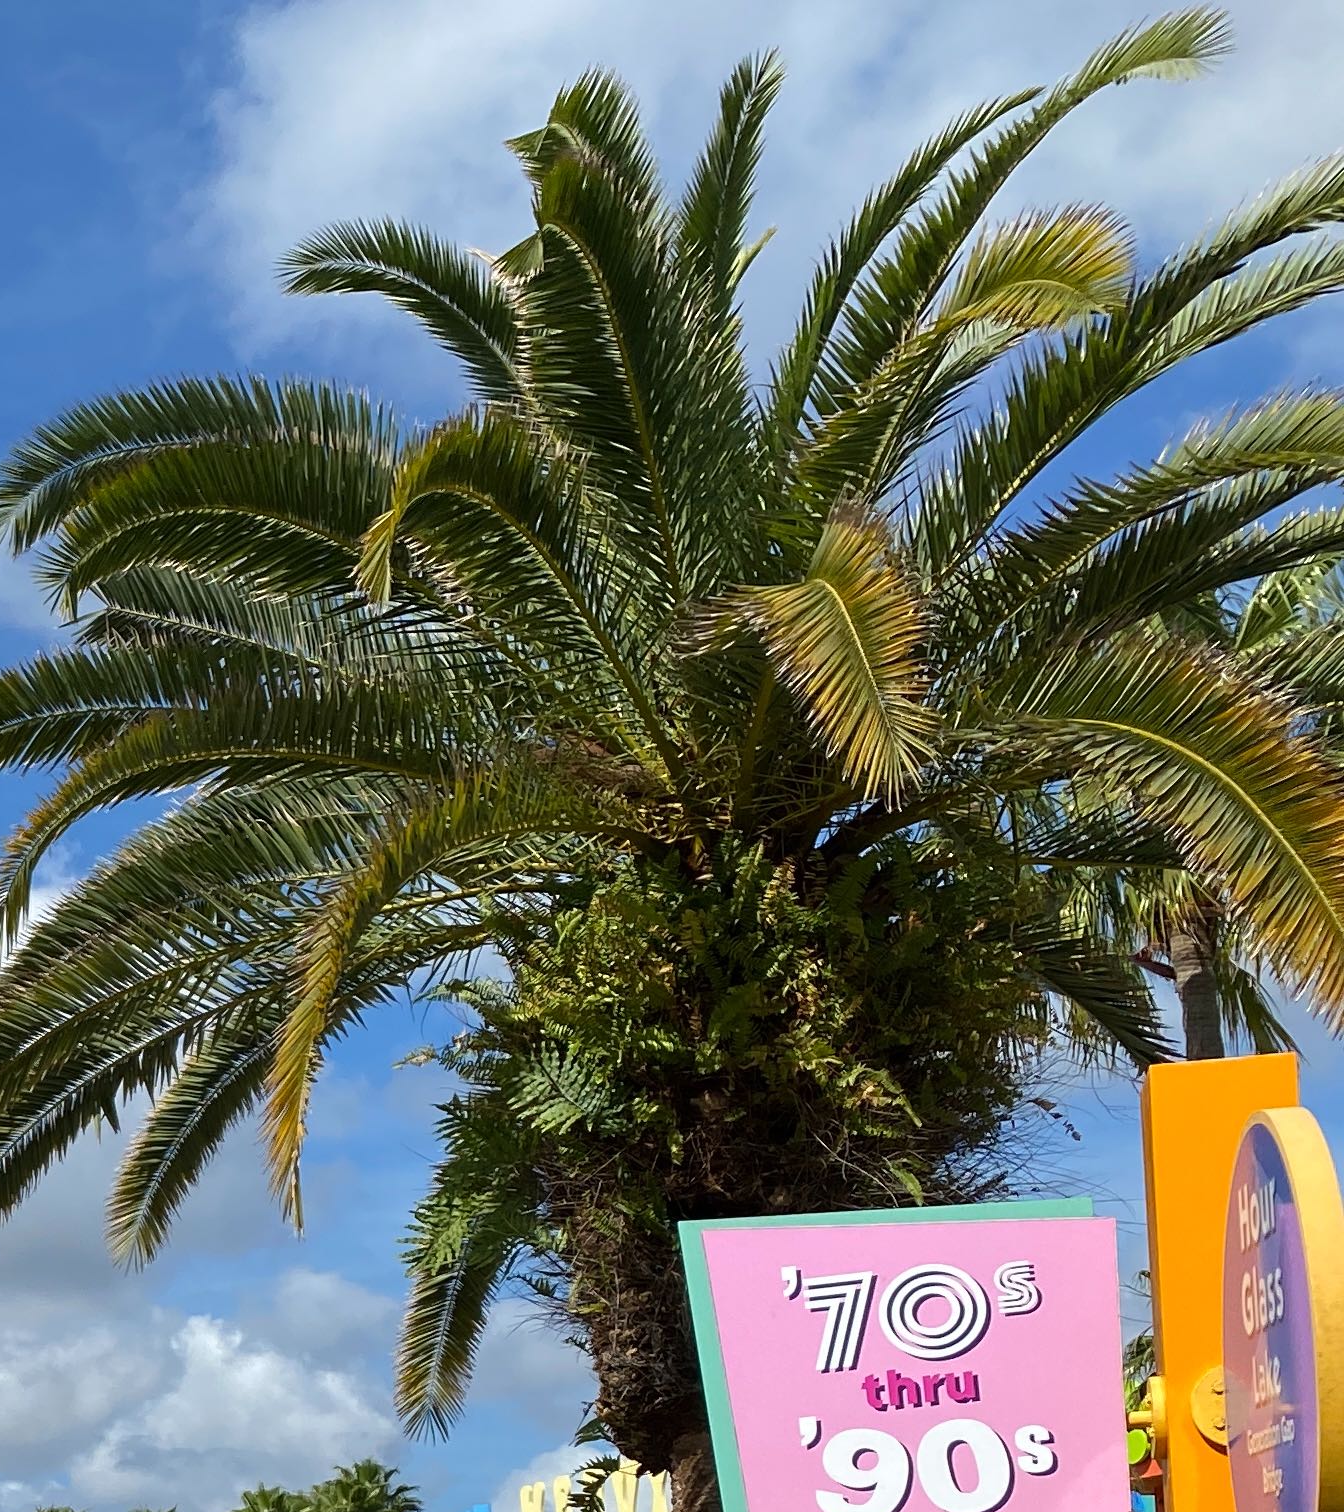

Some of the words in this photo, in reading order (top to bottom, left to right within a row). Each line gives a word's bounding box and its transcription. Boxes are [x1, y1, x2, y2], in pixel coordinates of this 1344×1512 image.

[1238, 1176, 1276, 1251] Hour
[780, 1260, 1041, 1374] '70s
[1241, 1265, 1285, 1336] Glass
[862, 1369, 980, 1412] thru
[1251, 1350, 1282, 1403] Lake
